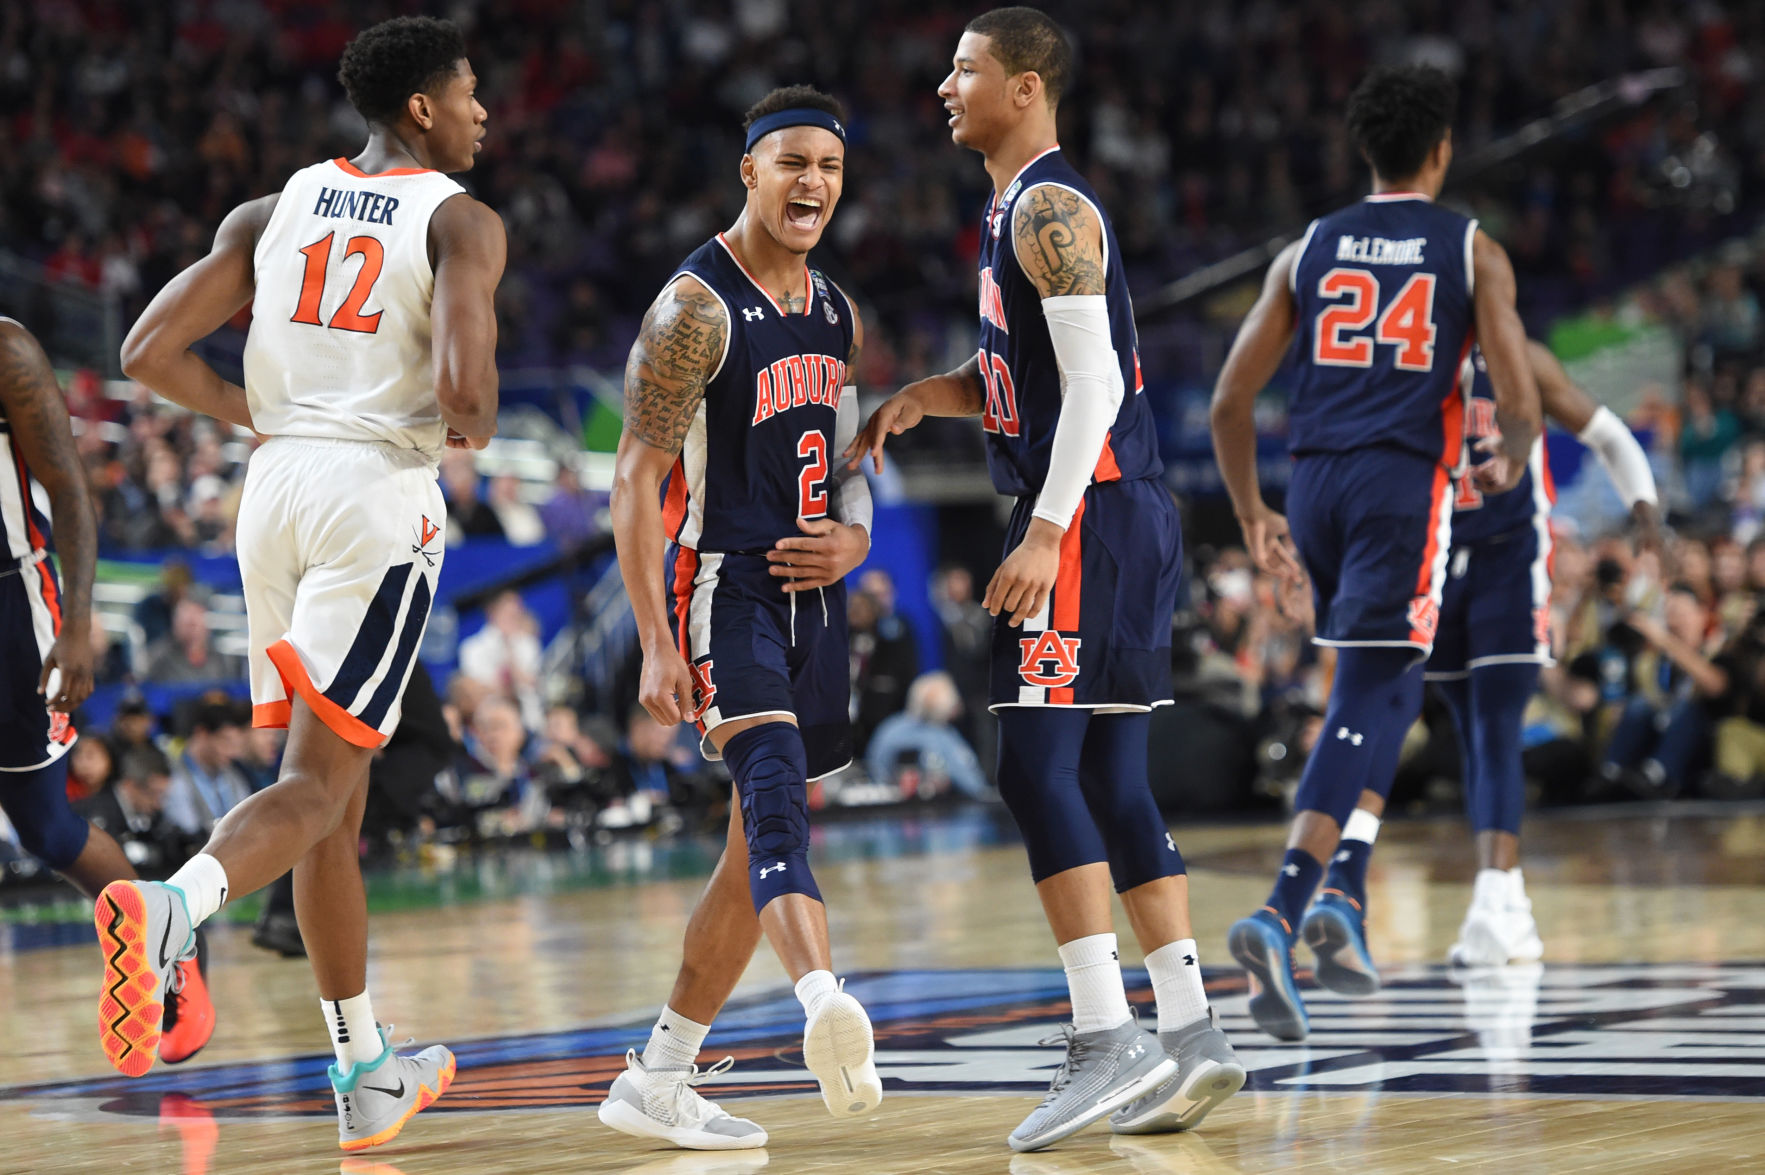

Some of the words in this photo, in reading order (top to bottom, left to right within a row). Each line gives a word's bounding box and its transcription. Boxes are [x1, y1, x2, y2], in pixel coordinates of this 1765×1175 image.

[313, 186, 399, 225] HUNTER
[290, 230, 384, 334] 12
[1313, 267, 1437, 372] 24
[978, 348, 1020, 438] 10
[797, 429, 828, 519] 2
